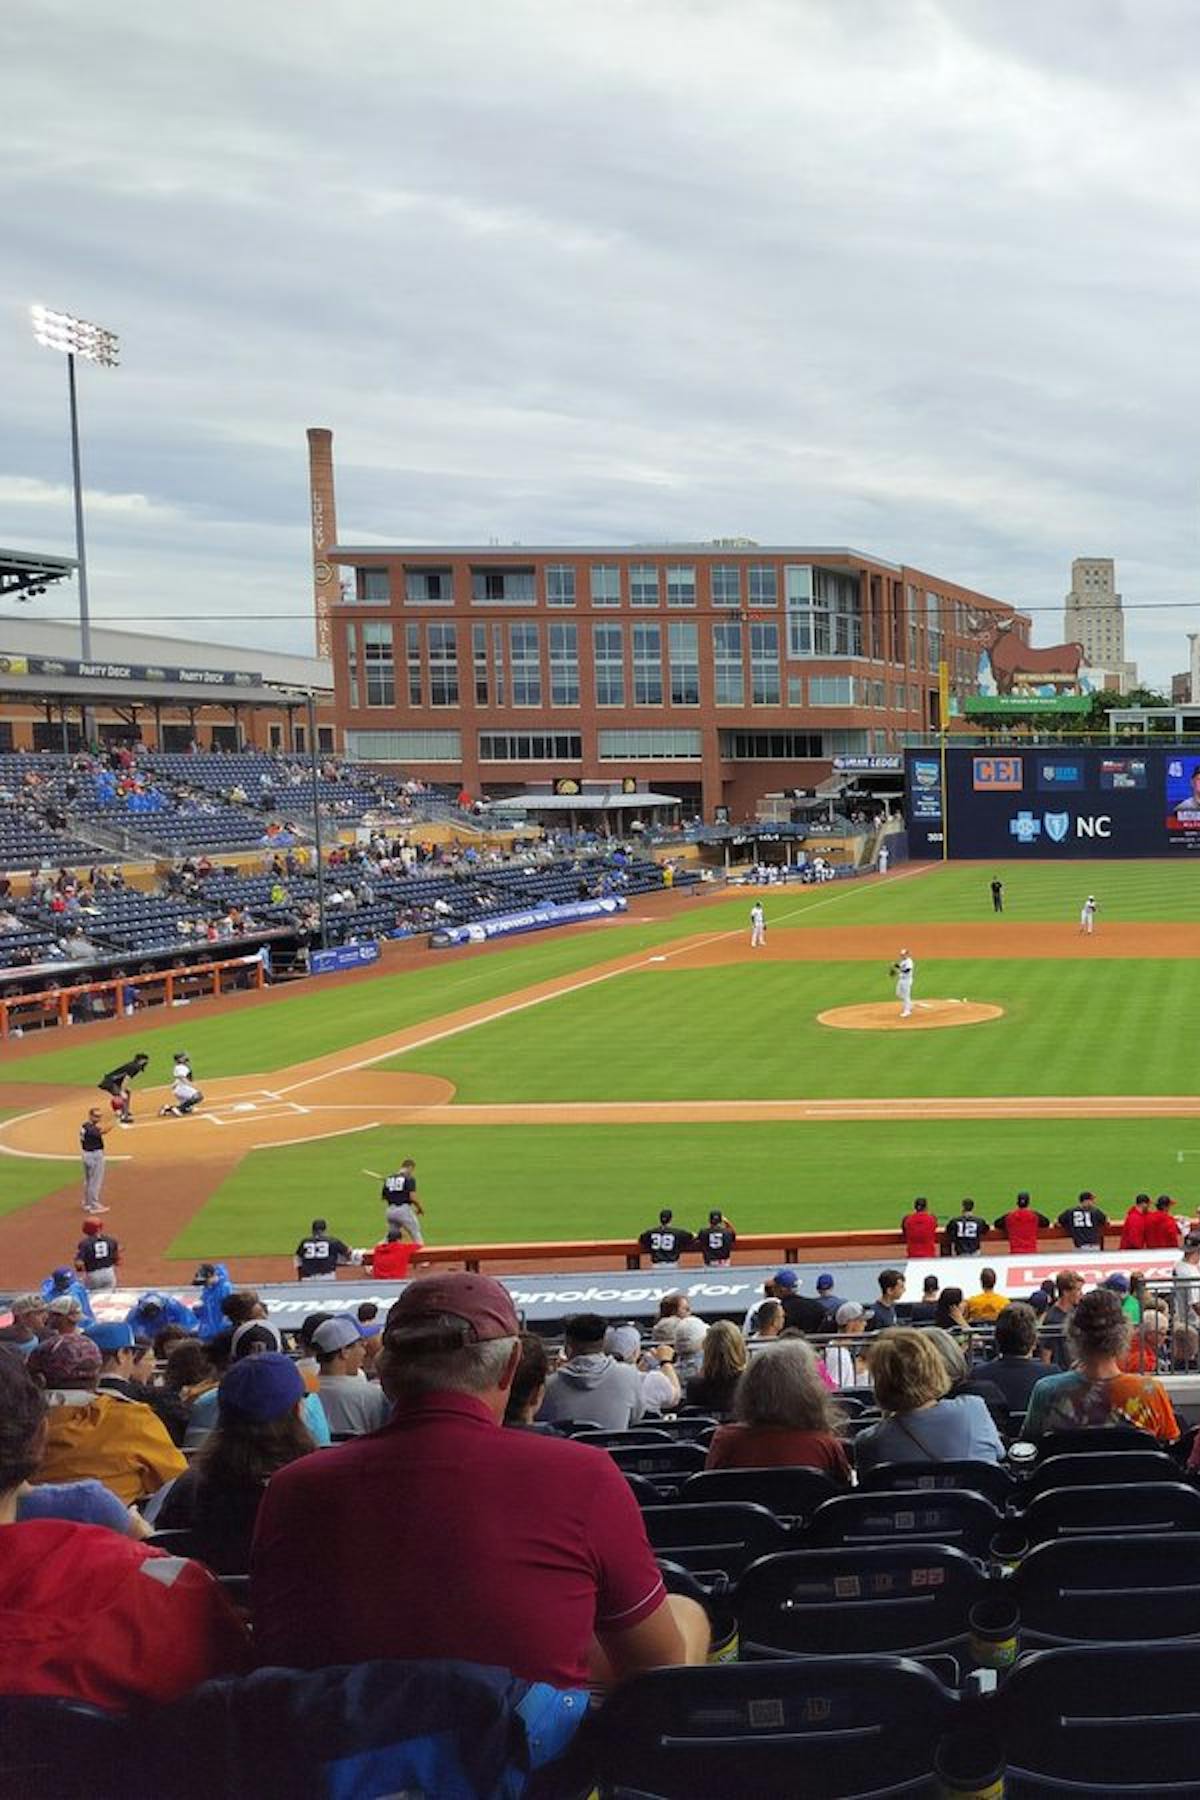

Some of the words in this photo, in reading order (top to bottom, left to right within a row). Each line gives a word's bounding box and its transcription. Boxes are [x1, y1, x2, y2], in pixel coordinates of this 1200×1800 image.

[79, 663, 106, 676] PARTY
[107, 665, 131, 678] DECK
[1077, 816, 1112, 838] NC
[1072, 1211, 1093, 1228] 21
[957, 1221, 978, 1238] 12
[650, 1232, 675, 1251] 38
[709, 1232, 723, 1249] 5
[94, 1241, 108, 1258] 9
[303, 1241, 330, 1258] 33
[687, 1282, 750, 1297] for
